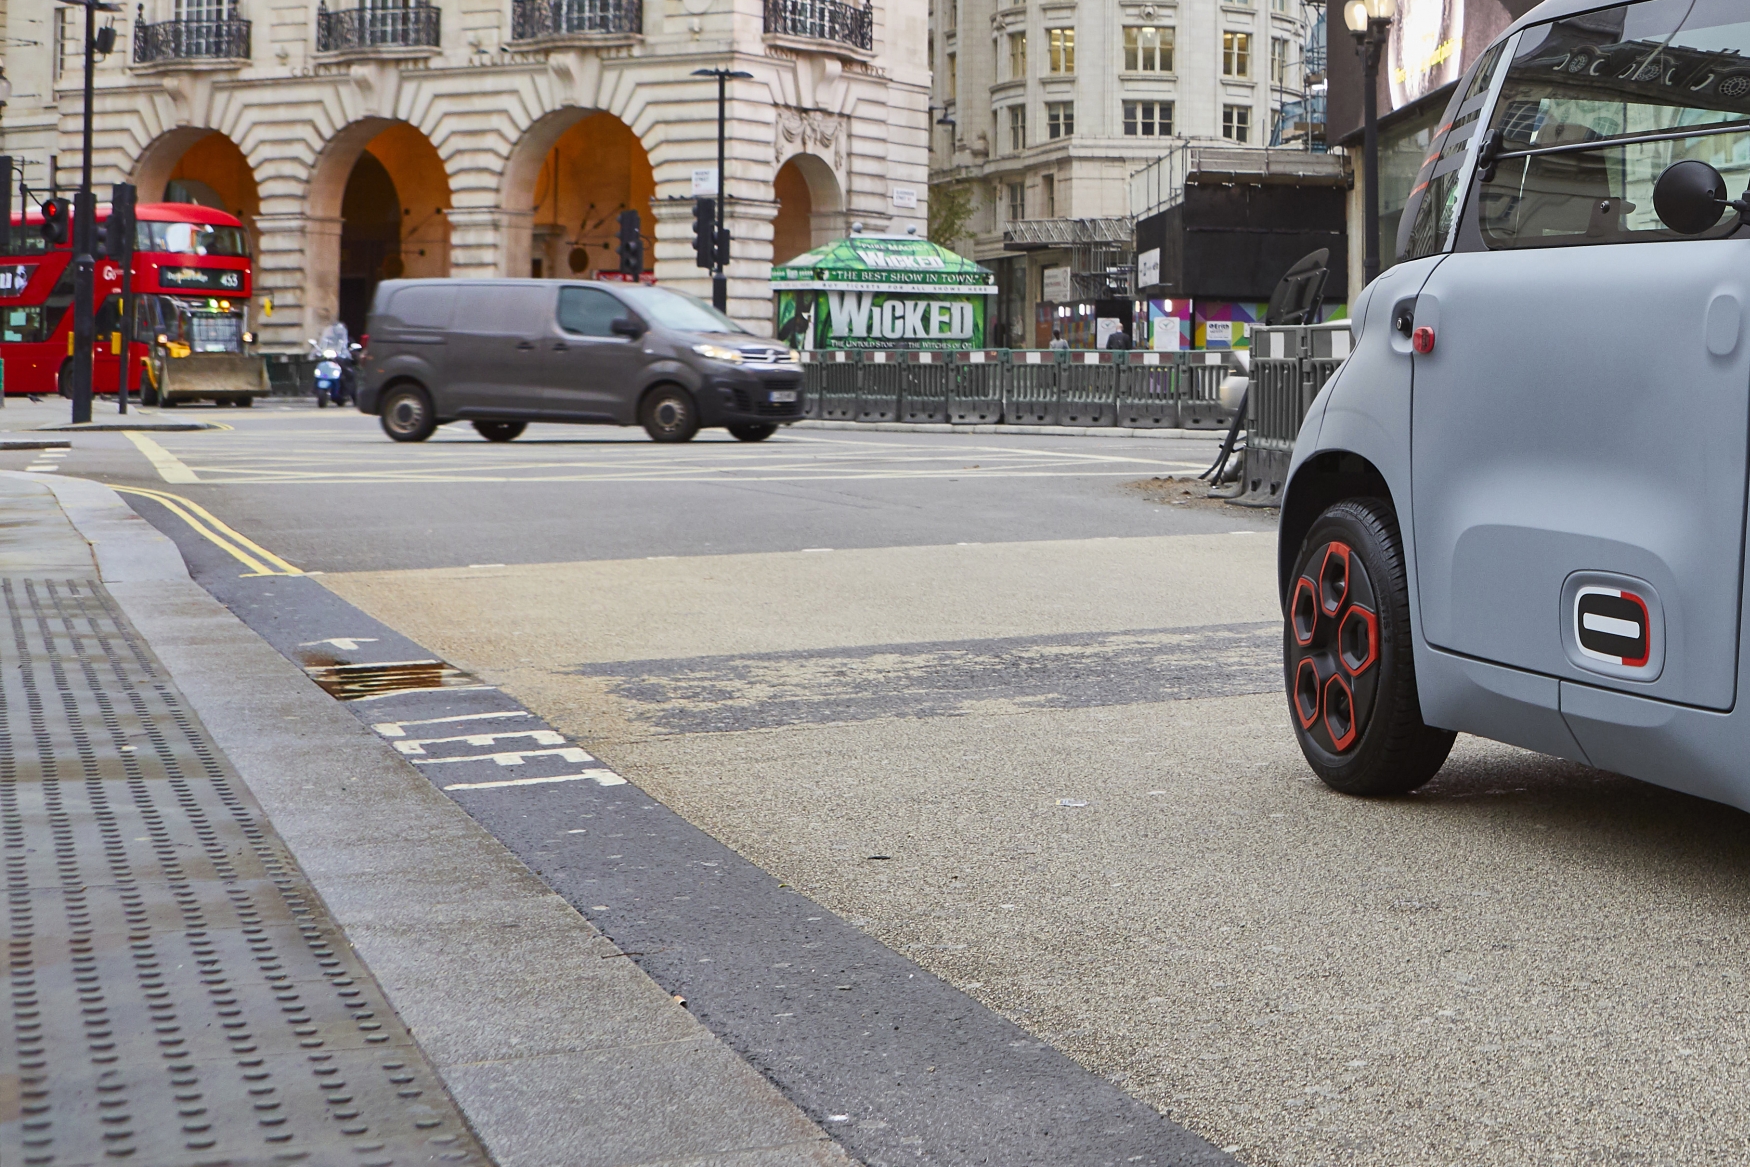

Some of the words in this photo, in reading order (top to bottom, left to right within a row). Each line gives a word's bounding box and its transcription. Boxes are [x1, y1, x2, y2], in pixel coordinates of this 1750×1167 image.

[861, 271, 888, 281] BEST
[890, 273, 923, 282] SHOW
[926, 274, 938, 283] IN
[831, 339, 845, 348] THE
[845, 339, 875, 348] UNTOLD
[908, 341, 920, 349] THE
[921, 340, 952, 350] WITCHES
[371, 710, 628, 791] LEFT
